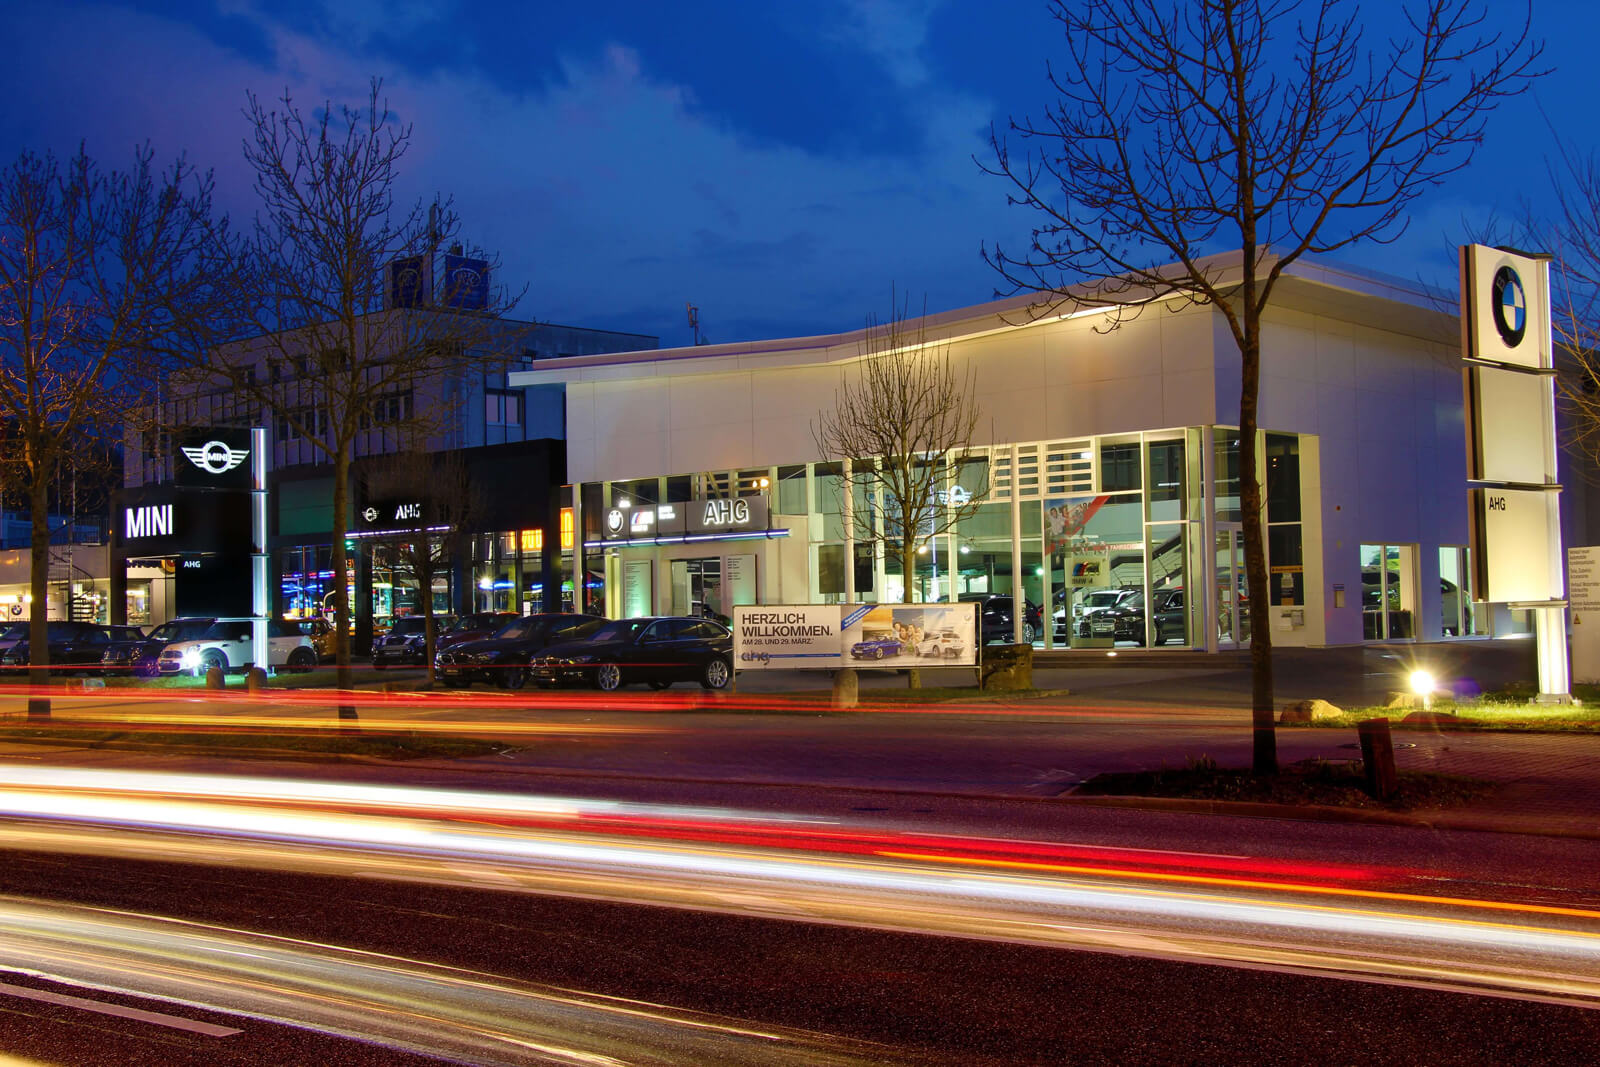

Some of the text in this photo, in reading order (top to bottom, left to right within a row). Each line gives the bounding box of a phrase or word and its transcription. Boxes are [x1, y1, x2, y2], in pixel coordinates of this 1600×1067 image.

[208, 453, 228, 462] MINI
[1489, 496, 1506, 511] AHG
[395, 503, 421, 520] AHG
[704, 499, 749, 525] AHG
[126, 504, 173, 538] MINI
[183, 560, 201, 568] AHG
[742, 613, 806, 624] HERZLICH
[742, 625, 833, 637] WILLKOMMEN.
